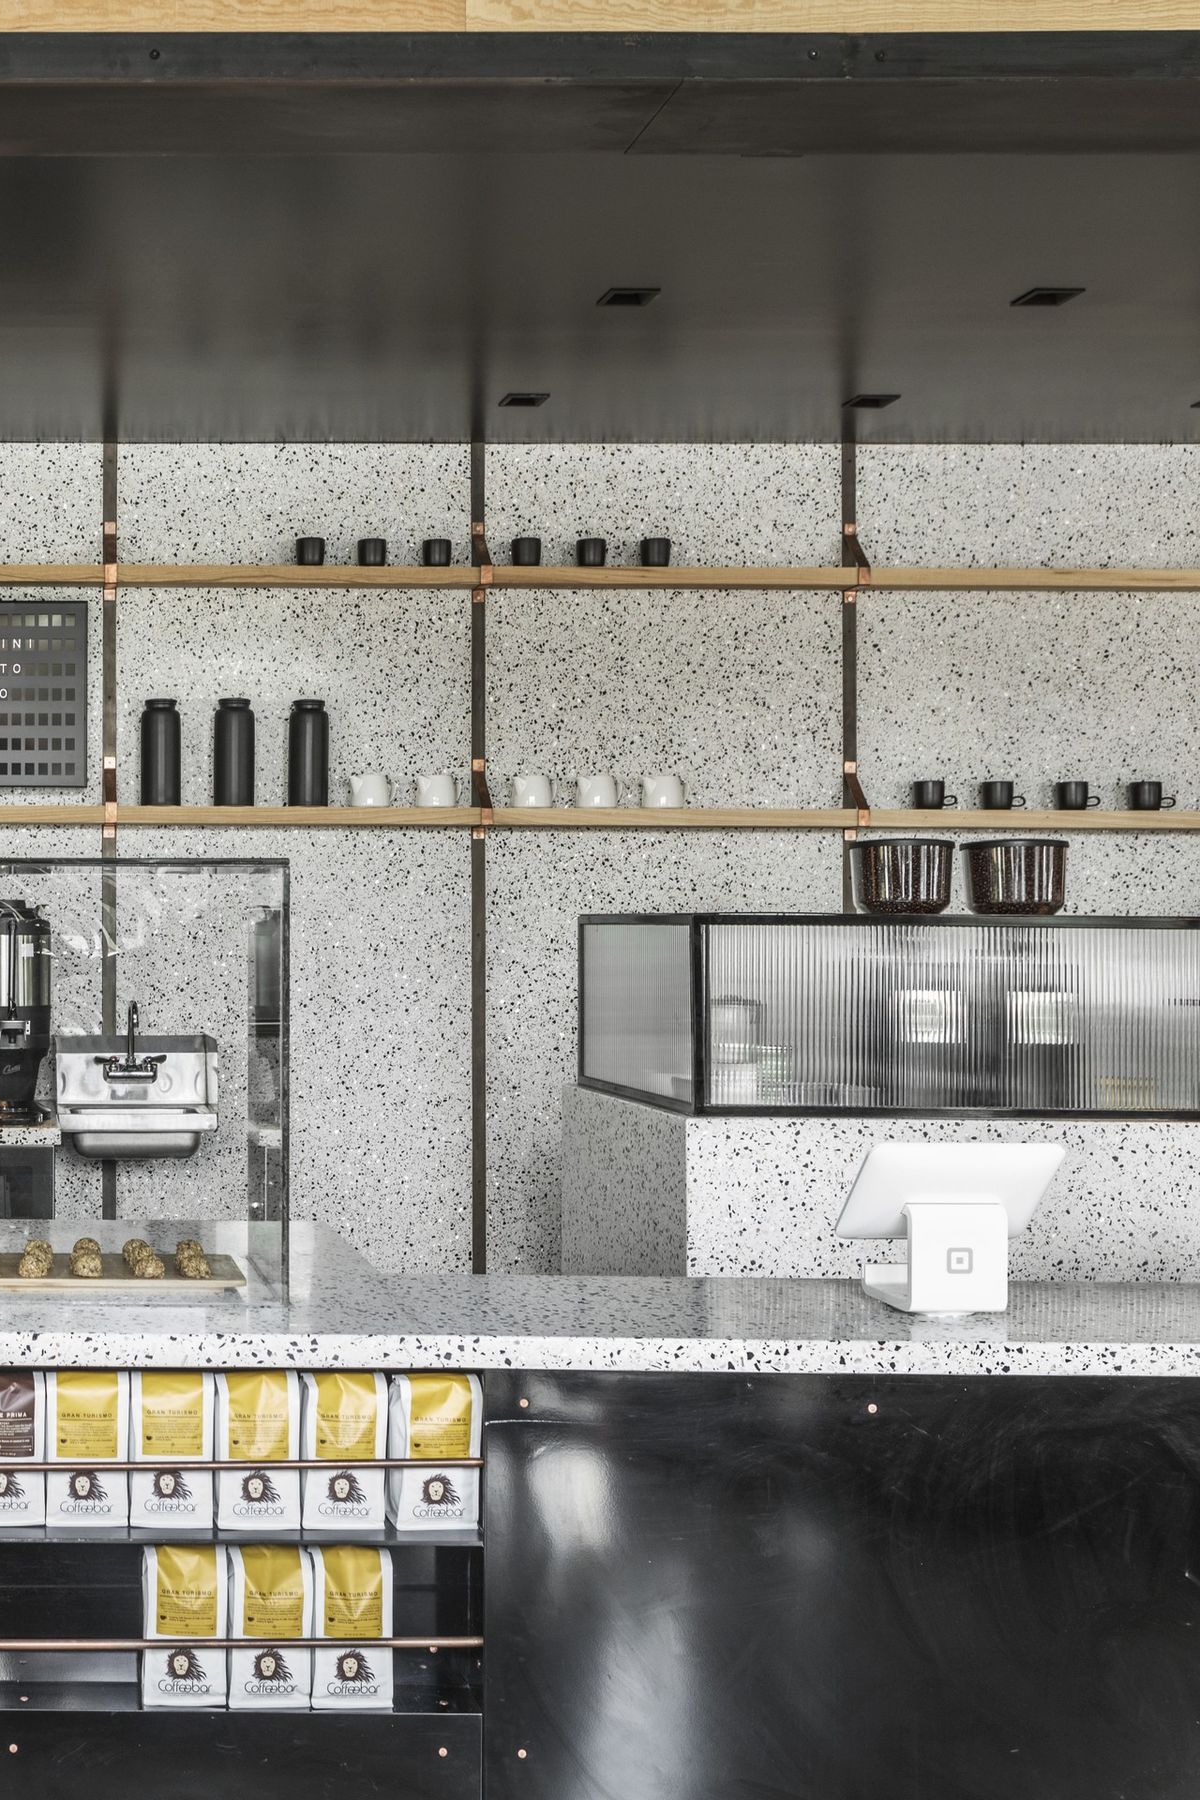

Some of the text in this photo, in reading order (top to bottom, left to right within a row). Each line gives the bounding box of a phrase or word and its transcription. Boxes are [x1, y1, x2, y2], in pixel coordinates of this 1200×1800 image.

[59, 1500, 114, 1514] Coffeebar
[144, 1499, 199, 1512] Coffeebar
[232, 1503, 287, 1516] Coffeebar
[318, 1502, 373, 1516] Coffeebar
[412, 1505, 467, 1517] Coffeebar
[158, 1679, 213, 1694] Coffeebar
[244, 1681, 298, 1695] Coffeebar
[326, 1682, 381, 1696] Coffeebar
